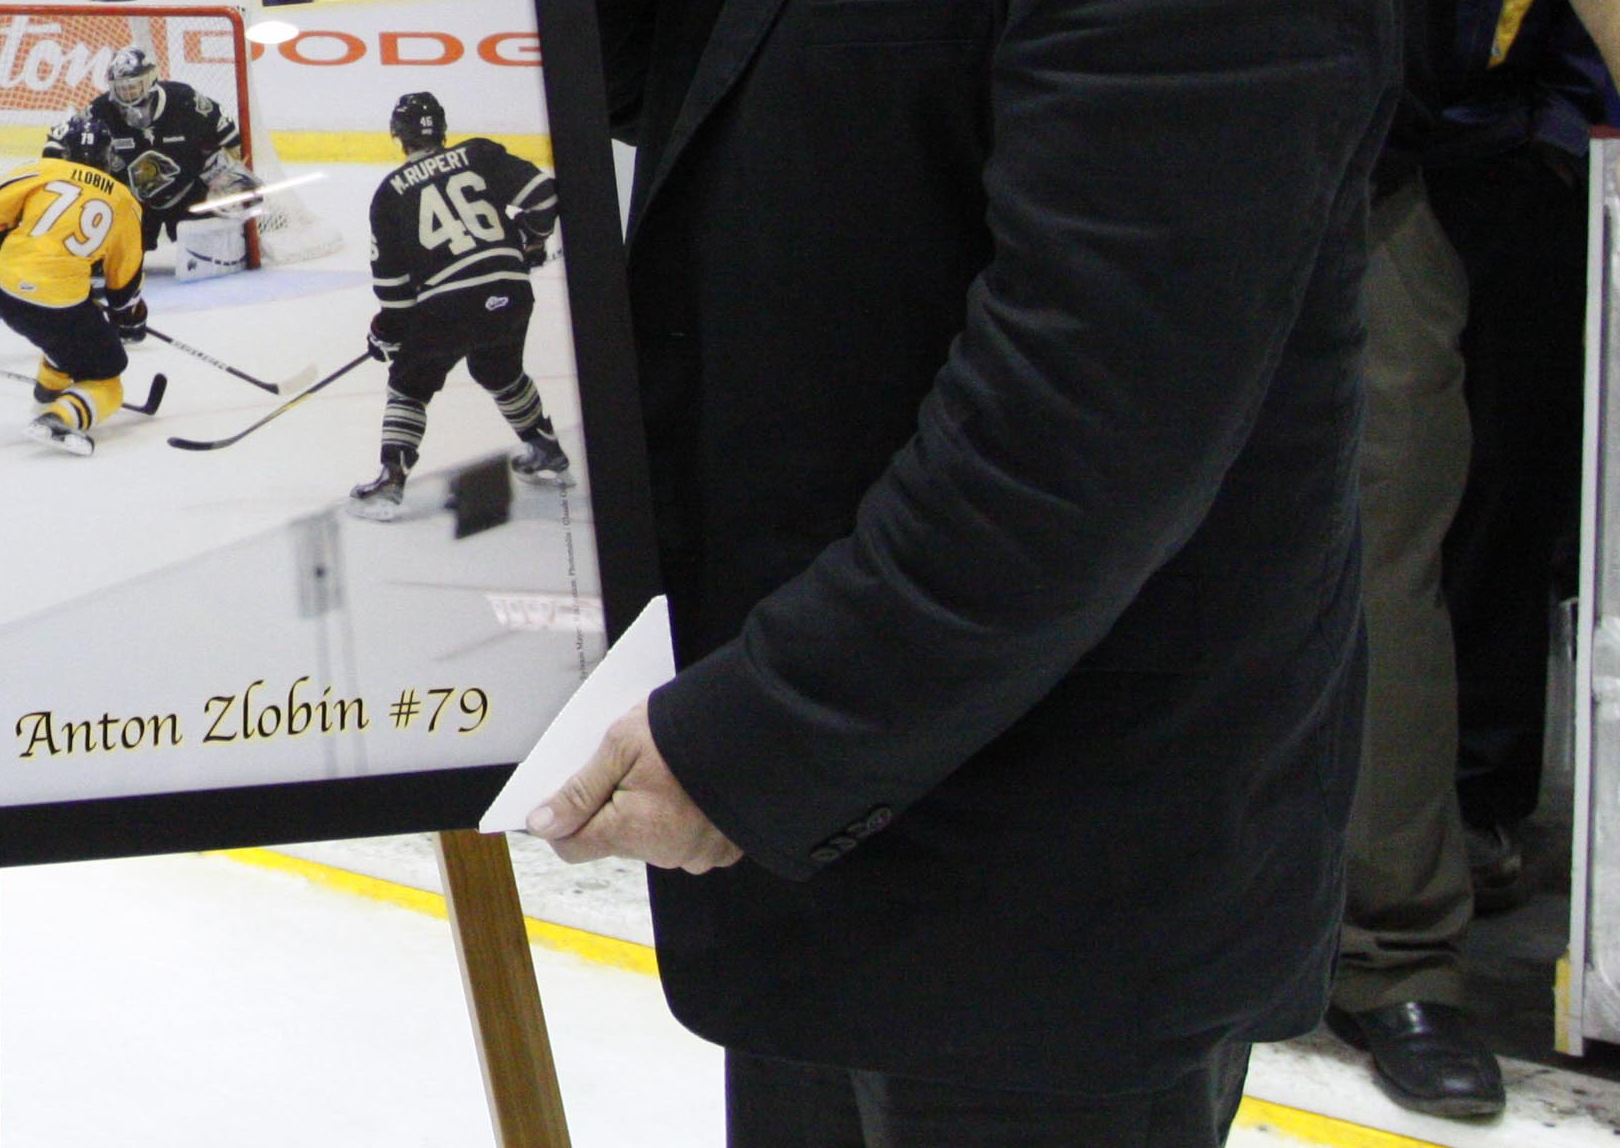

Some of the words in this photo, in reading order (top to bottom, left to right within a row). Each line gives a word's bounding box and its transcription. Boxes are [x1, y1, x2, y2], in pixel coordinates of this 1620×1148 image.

[28, 179, 115, 258] 79
[418, 170, 506, 256] 46
[14, 710, 183, 759] Anton
[201, 675, 370, 745] Zlobin
[388, 686, 490, 734] #79
